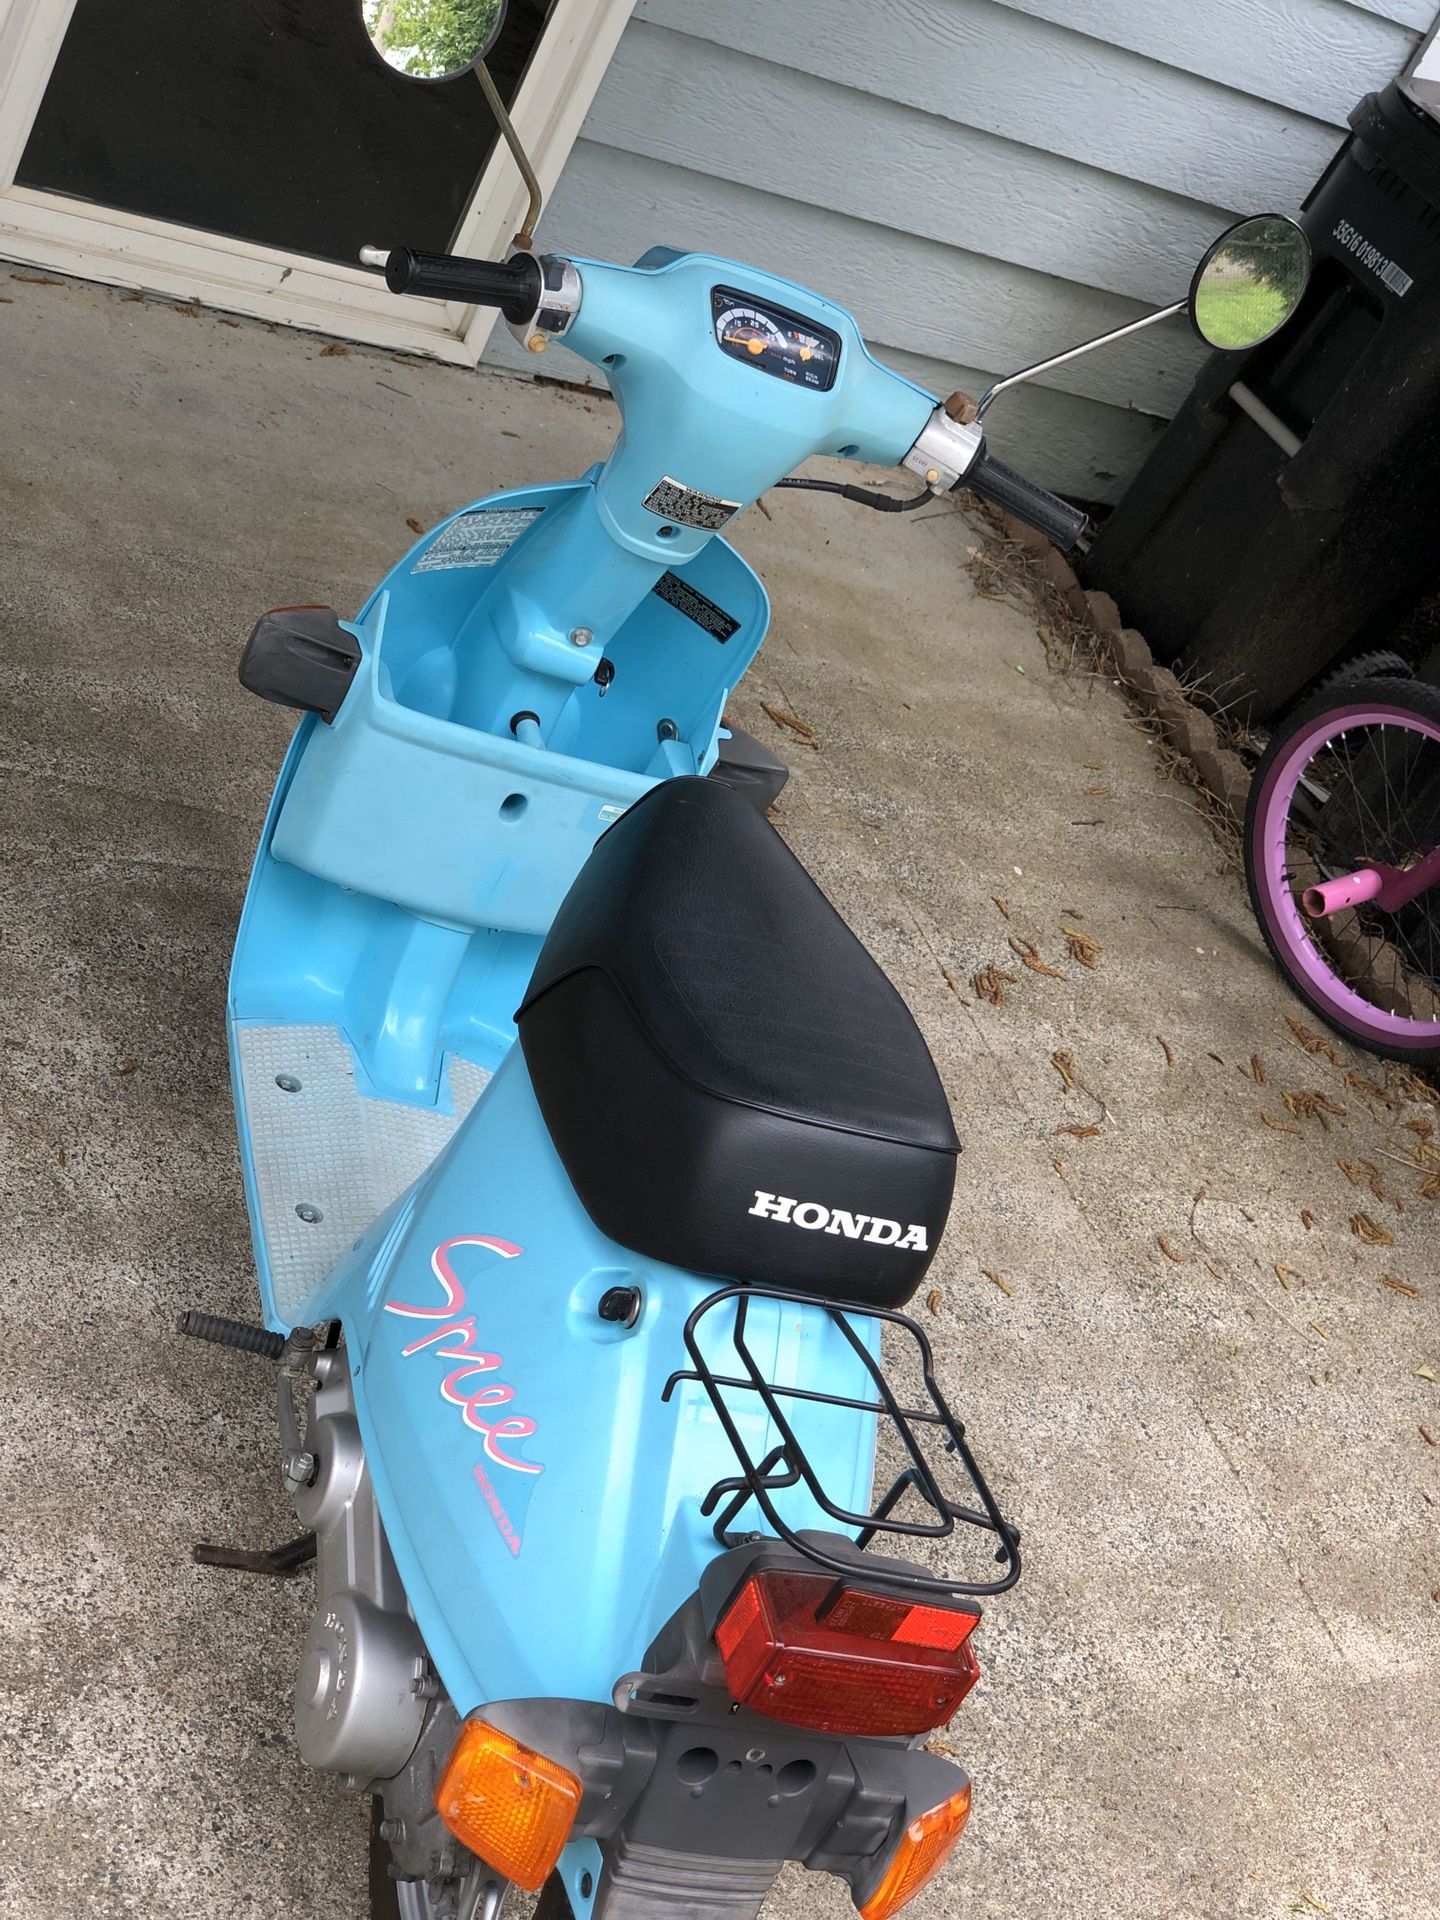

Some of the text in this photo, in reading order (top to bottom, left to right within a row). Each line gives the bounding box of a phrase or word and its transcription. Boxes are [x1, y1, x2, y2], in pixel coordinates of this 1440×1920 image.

[1332, 219, 1389, 276] 35G16 019813
[750, 319, 760, 328] 25
[782, 356, 796, 366] mph
[749, 1190, 928, 1251] HONDA
[384, 1234, 545, 1474] Spree
[473, 1463, 521, 1556] HONDA
